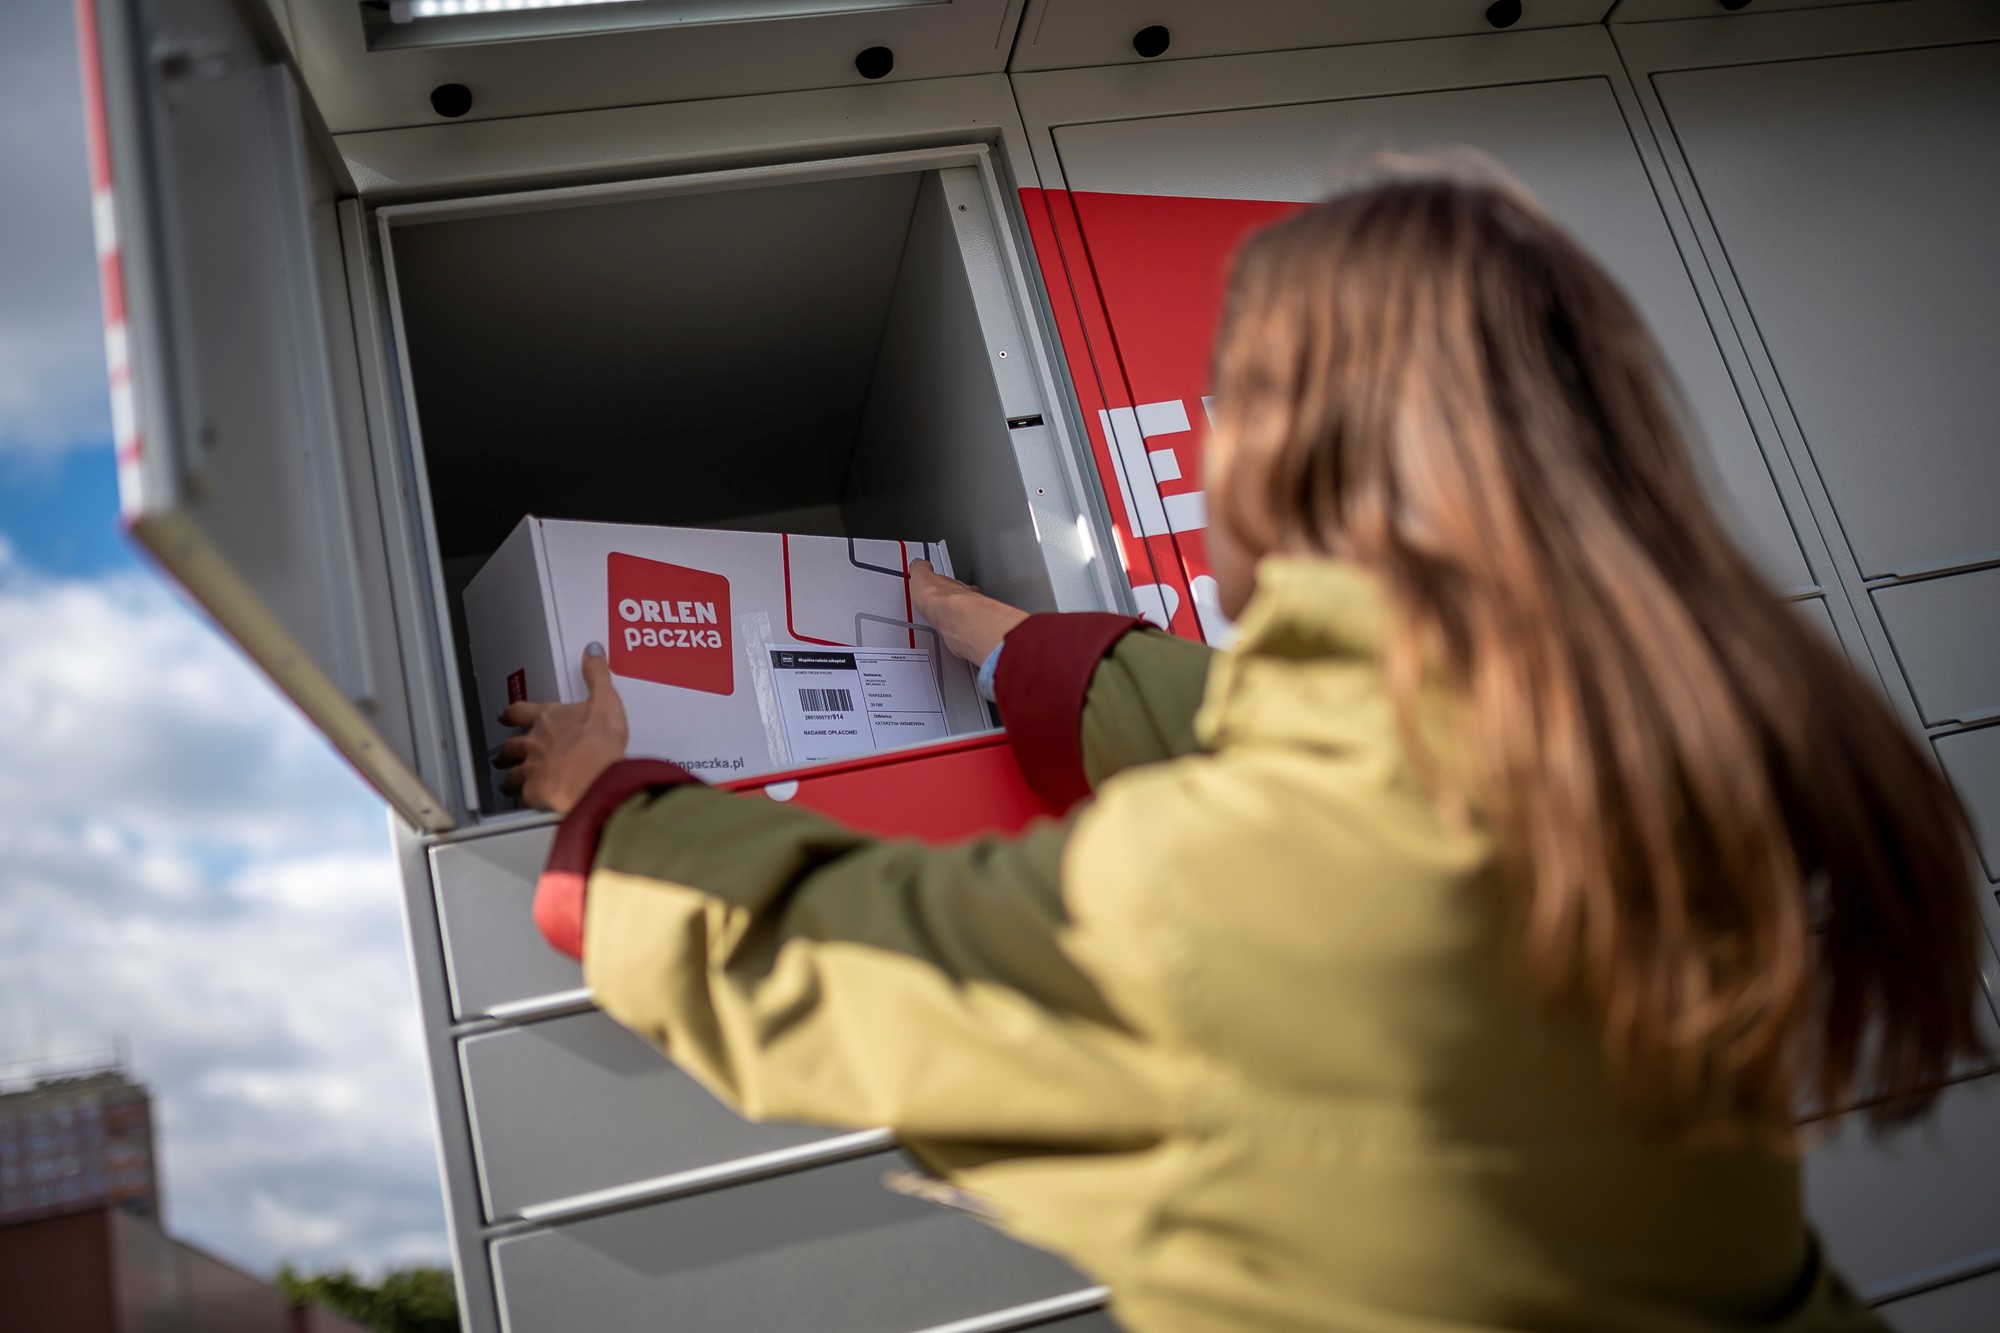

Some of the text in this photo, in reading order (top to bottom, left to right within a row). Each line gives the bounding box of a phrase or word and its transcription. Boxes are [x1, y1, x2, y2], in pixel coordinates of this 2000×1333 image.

[1097, 396, 1216, 539] E
[617, 598, 718, 625] ORLEN
[623, 627, 723, 652] paczka
